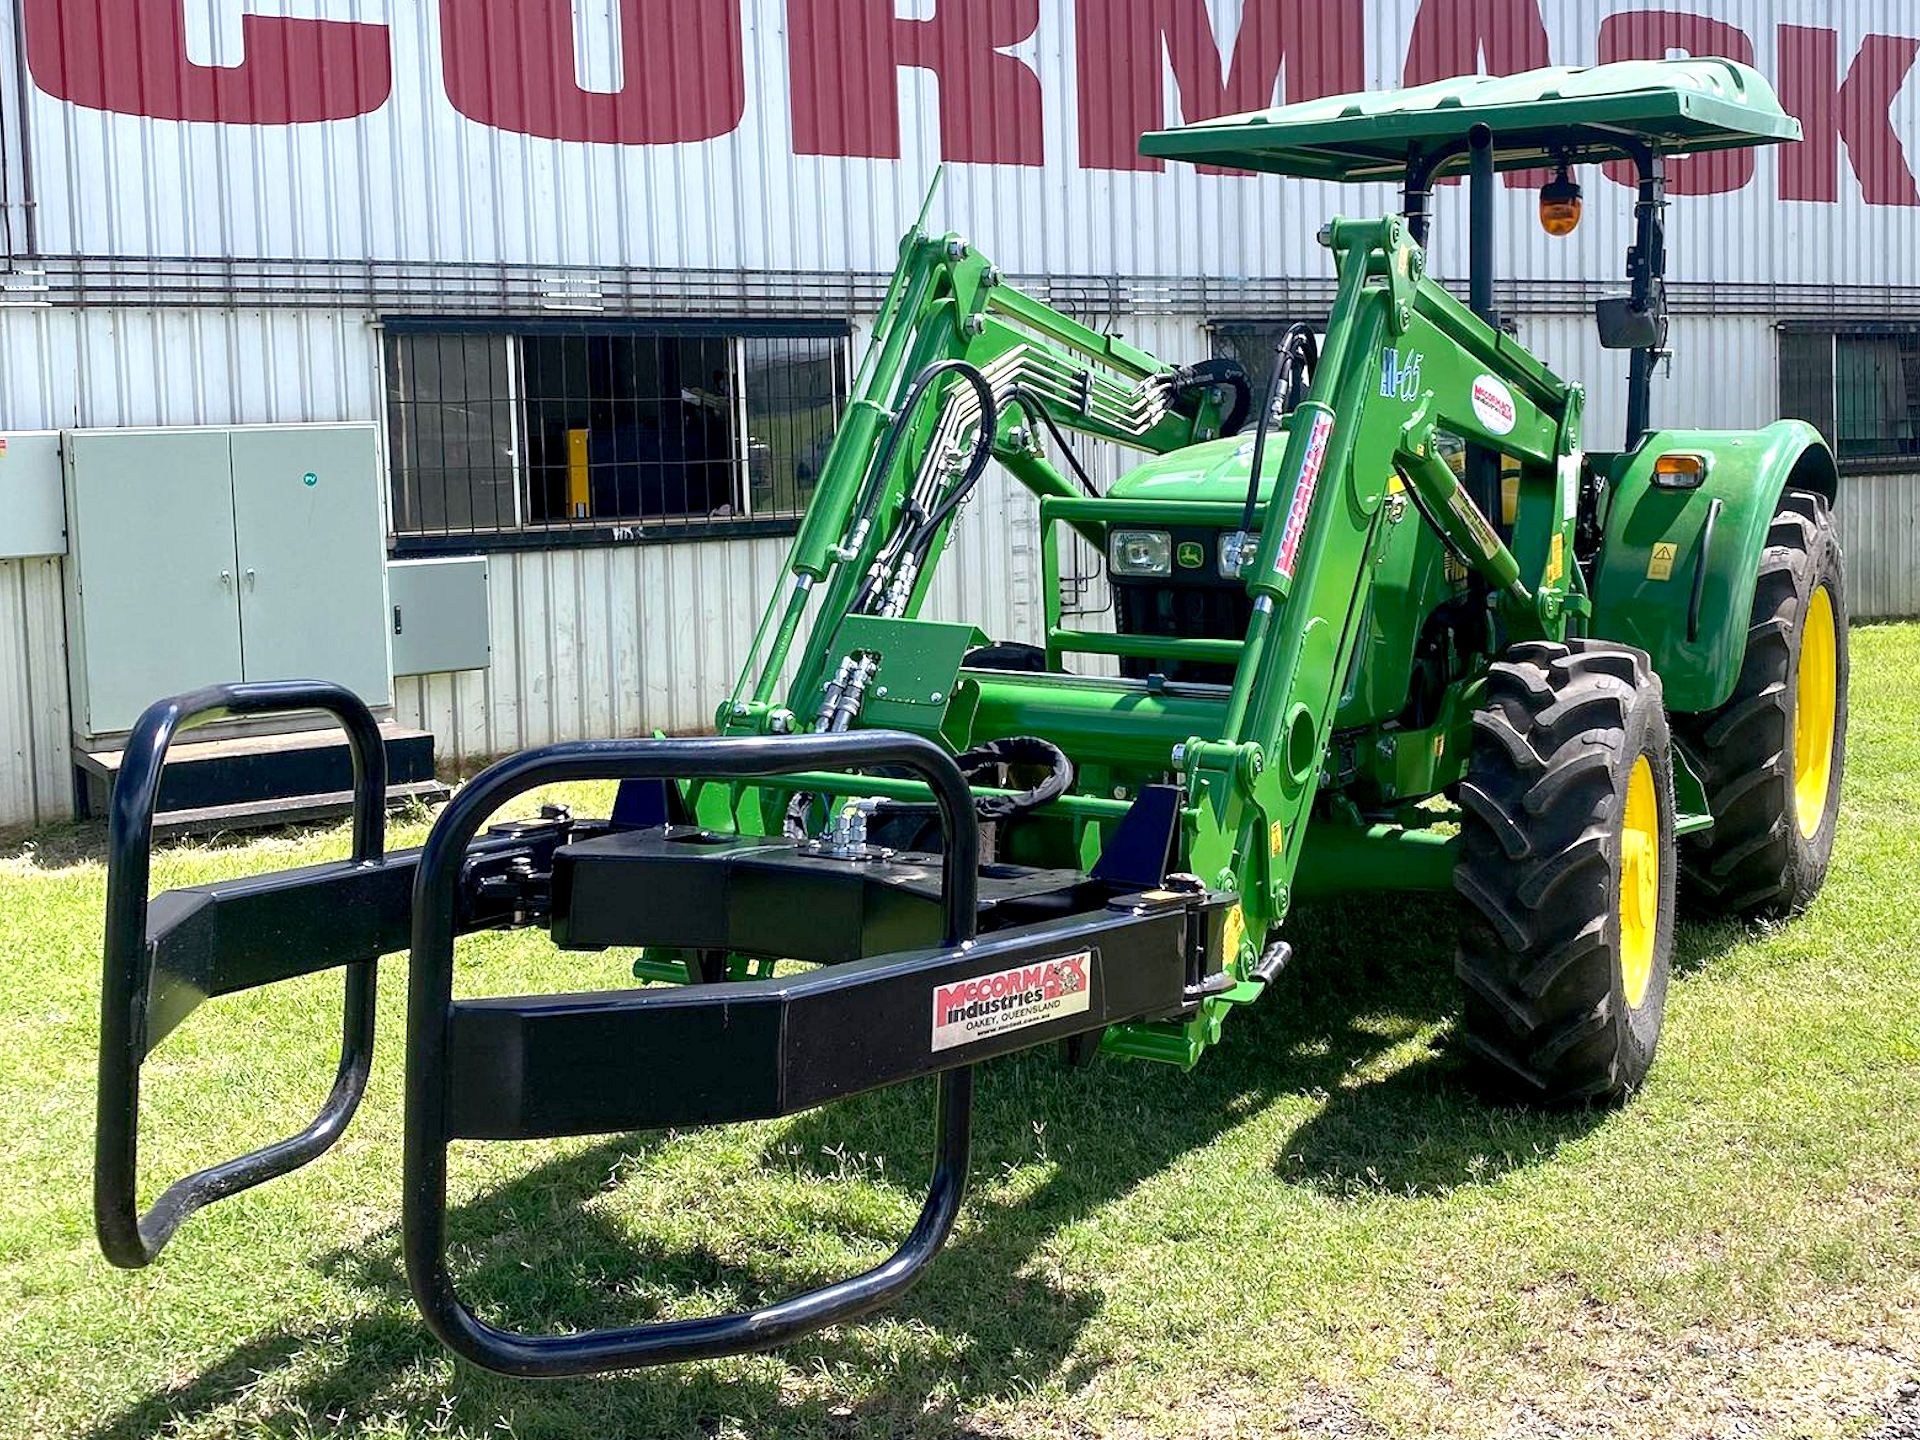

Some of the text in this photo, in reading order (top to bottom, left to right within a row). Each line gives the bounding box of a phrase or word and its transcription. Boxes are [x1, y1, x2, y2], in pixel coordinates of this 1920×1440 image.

[947, 989, 1044, 1024] industries
[966, 1000, 1061, 1031] OAKEY, QUEENSLAND
